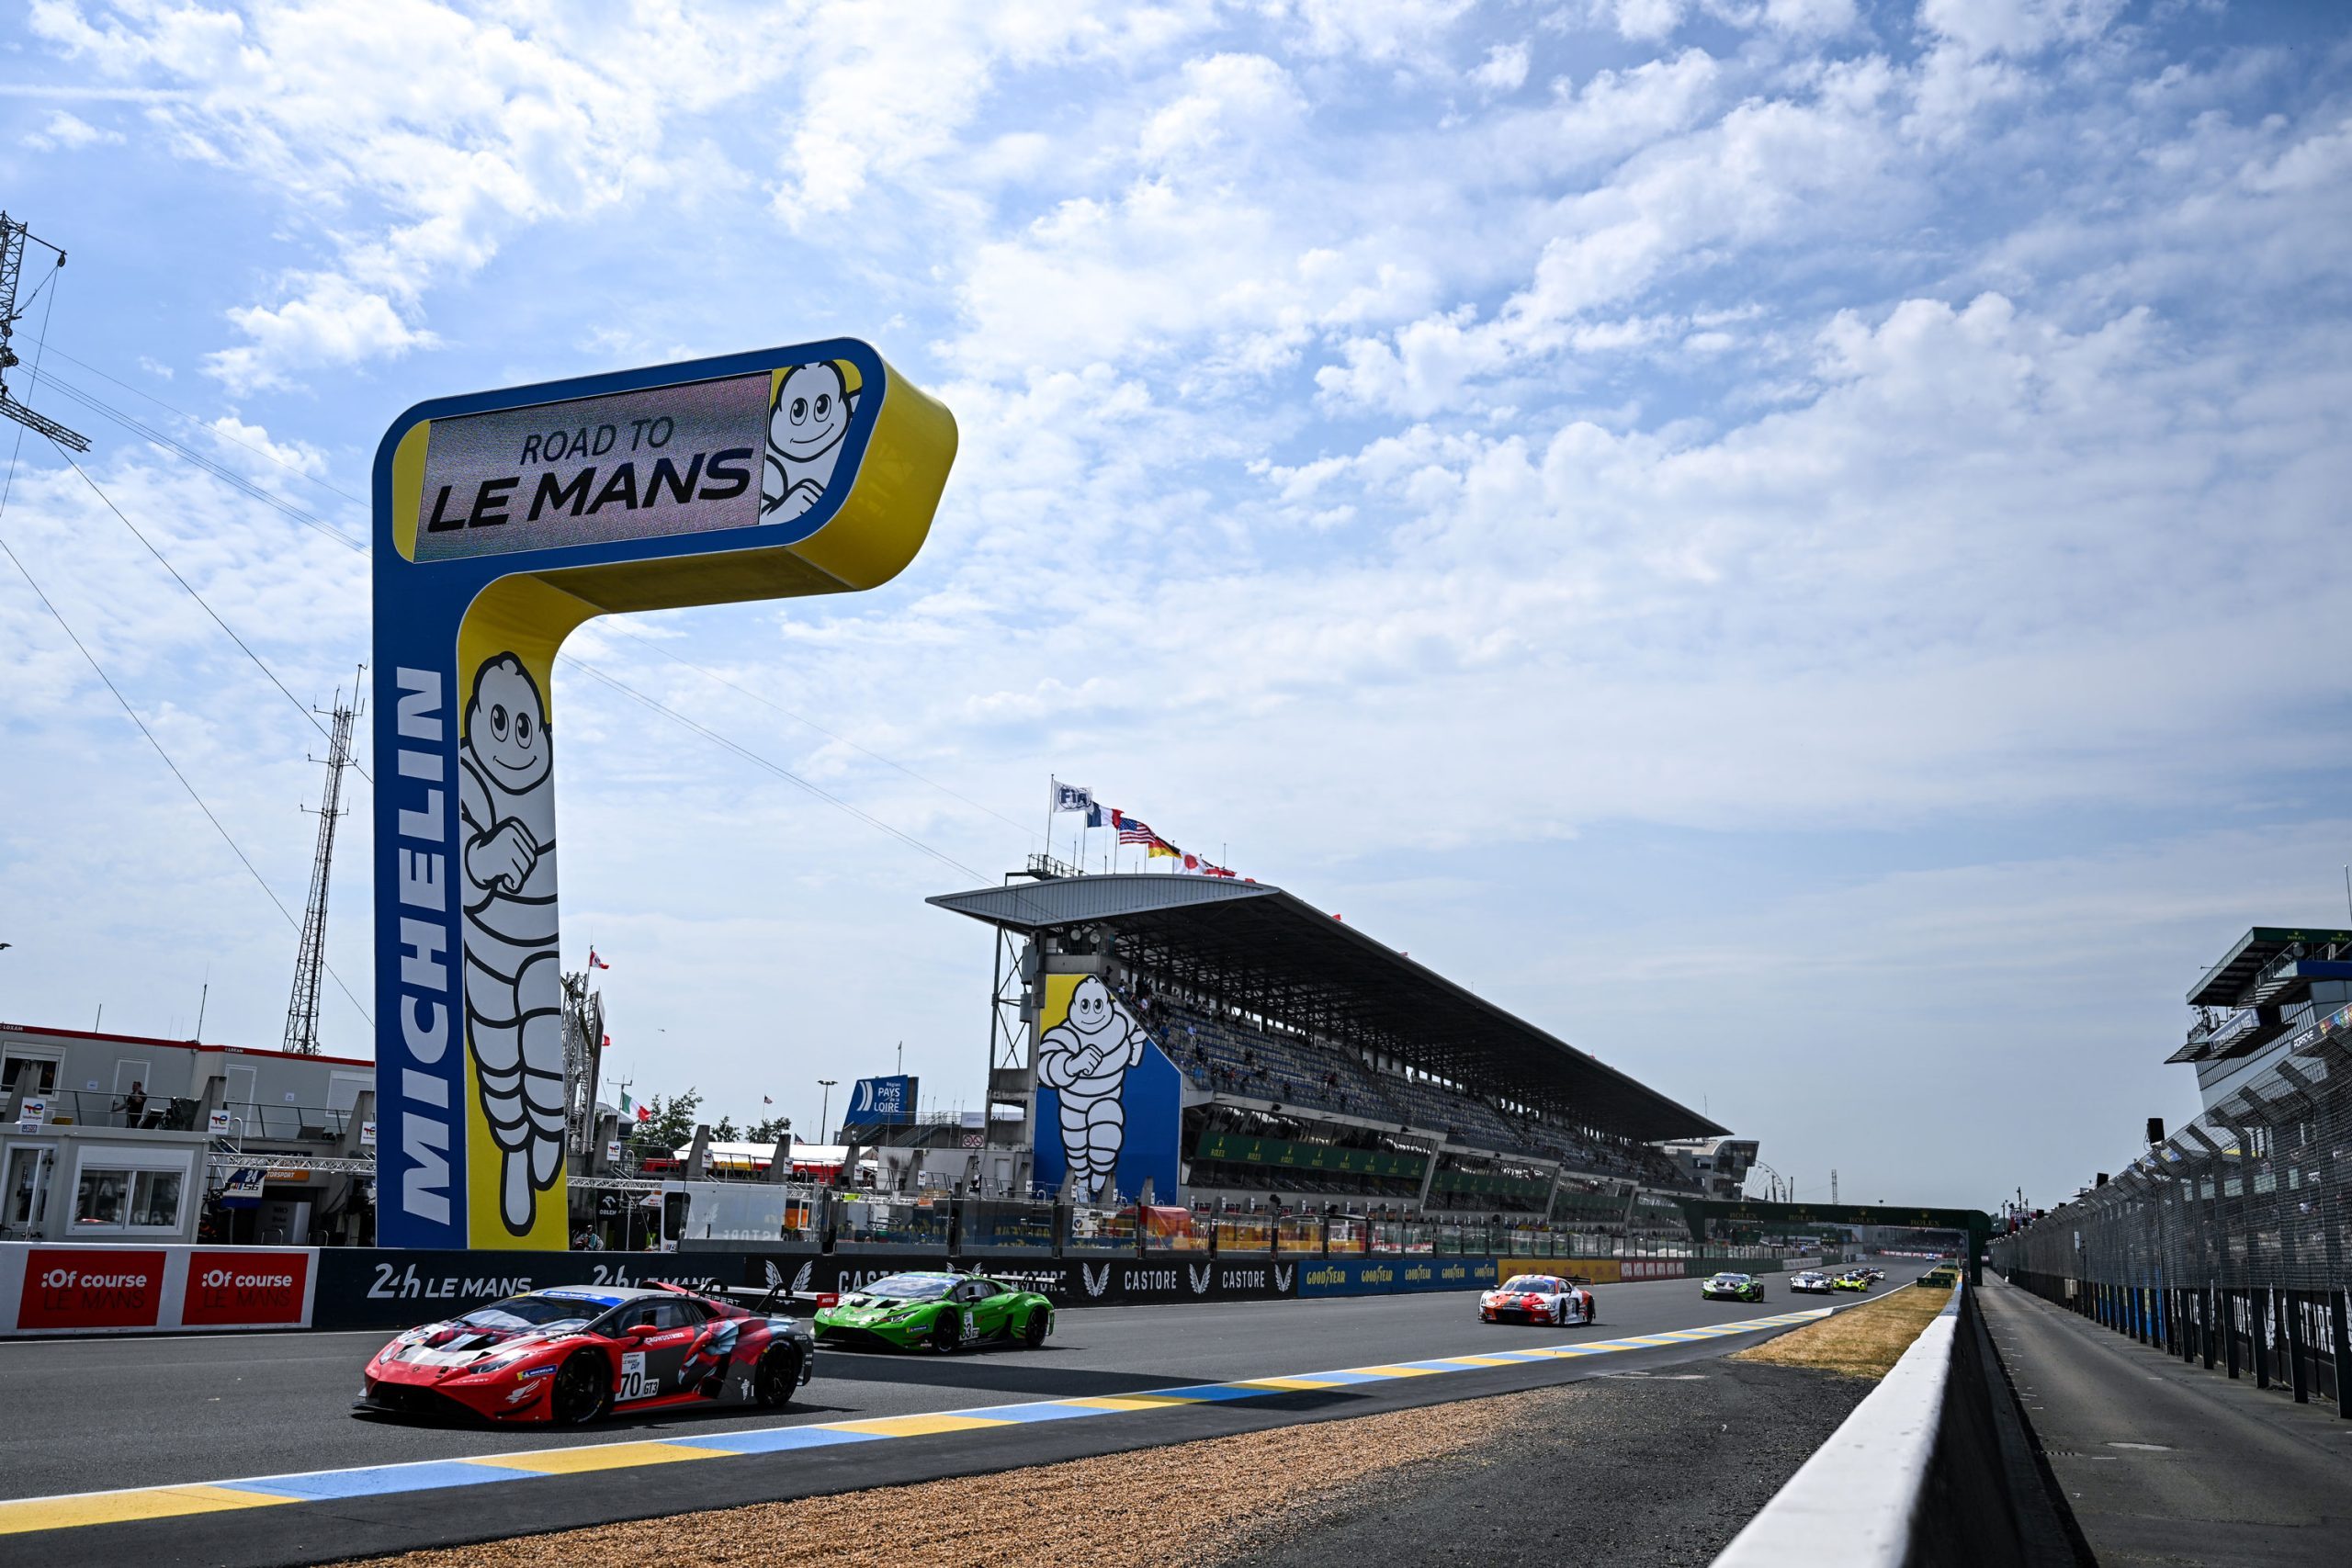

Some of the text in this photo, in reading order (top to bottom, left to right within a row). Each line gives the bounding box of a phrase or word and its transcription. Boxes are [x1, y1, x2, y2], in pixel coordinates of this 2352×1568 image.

[520, 416, 674, 466] ROAD TO
[427, 447, 754, 533] LE MANS
[396, 666, 451, 1225] MICHELIN
[878, 1088, 900, 1098] PAYS
[874, 1102, 899, 1112] LOIRE
[244, 1170, 258, 1183] 24
[41, 1269, 147, 1288] :Of course
[202, 1269, 293, 1288] :Of course
[1124, 1270, 1177, 1291] CASTORE
[1223, 1270, 1265, 1288] CASTORE
[1306, 1268, 1346, 1287] GOODYEAR
[1361, 1267, 1393, 1283] GOODYEAR
[1405, 1266, 1431, 1281] GOODYEAR
[1442, 1265, 1465, 1280] GOODYEAR
[1474, 1265, 1495, 1278] GOODYEAR
[368, 1263, 532, 1299] 24h LE MANS
[699, 1292, 741, 1305] EIPERT
[619, 1371, 641, 1398] 70
[644, 1382, 658, 1394] GT3
